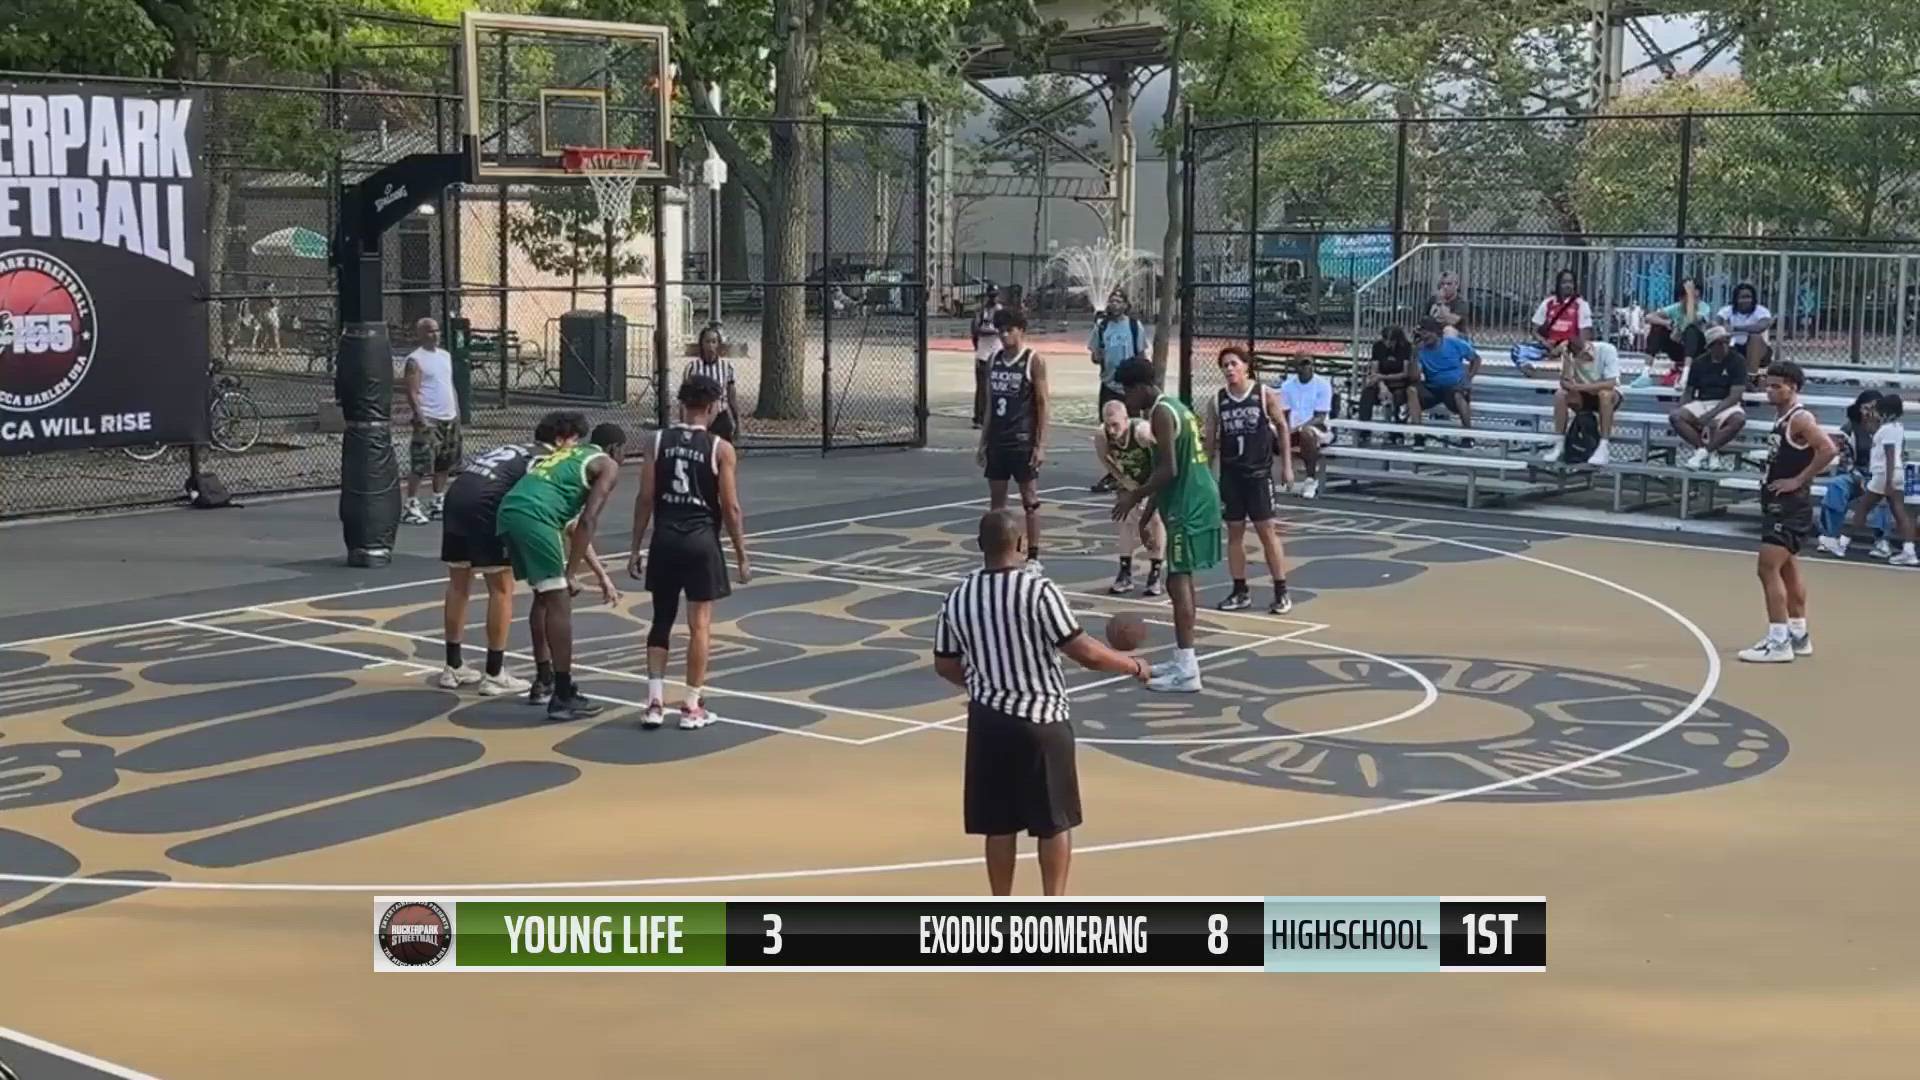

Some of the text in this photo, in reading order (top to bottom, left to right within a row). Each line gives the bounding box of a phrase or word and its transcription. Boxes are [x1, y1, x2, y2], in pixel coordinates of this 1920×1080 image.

[996, 397, 1008, 417] 3
[40, 417, 96, 437] WILL
[101, 412, 152, 433] RISE
[1236, 435, 1245, 456] 1
[672, 459, 690, 494] 5
